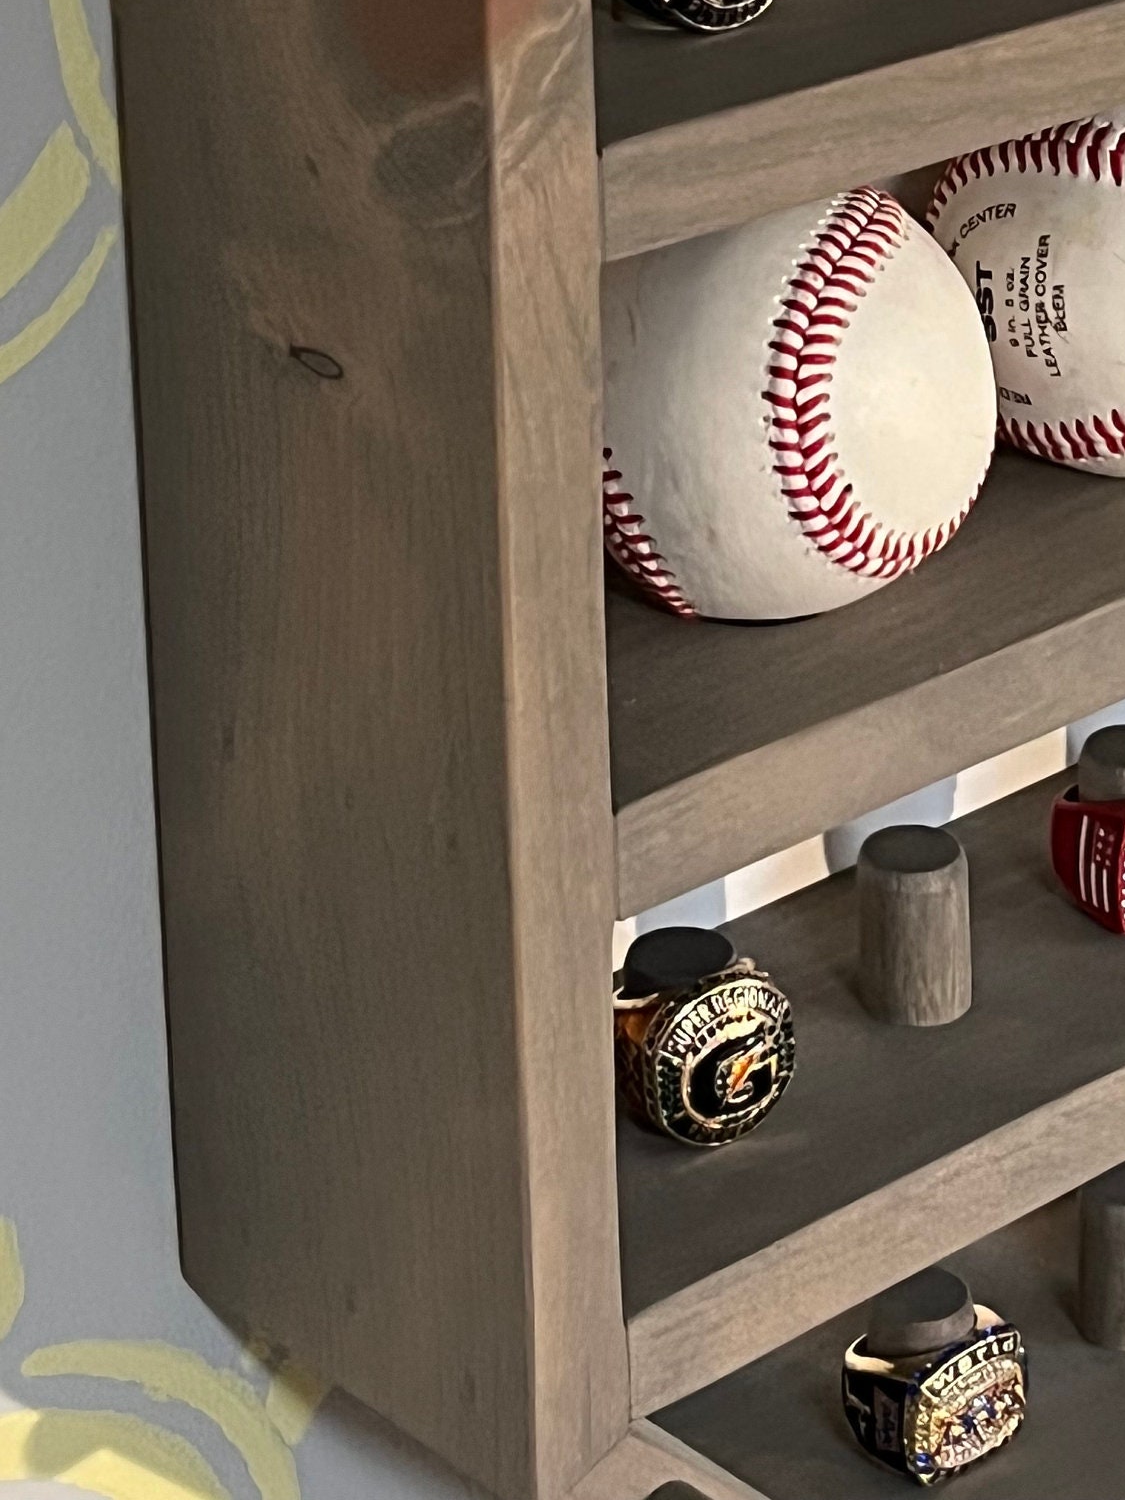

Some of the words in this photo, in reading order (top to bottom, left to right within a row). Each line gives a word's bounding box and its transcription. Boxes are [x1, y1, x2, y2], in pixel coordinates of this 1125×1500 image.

[958, 203, 1017, 239] CENTER
[1018, 256, 1031, 312] GRAIN
[1034, 234, 1051, 297] COVER
[1020, 318, 1039, 358] FULL
[1035, 301, 1062, 377] LEATHER
[666, 1003, 715, 1054] SUPER
